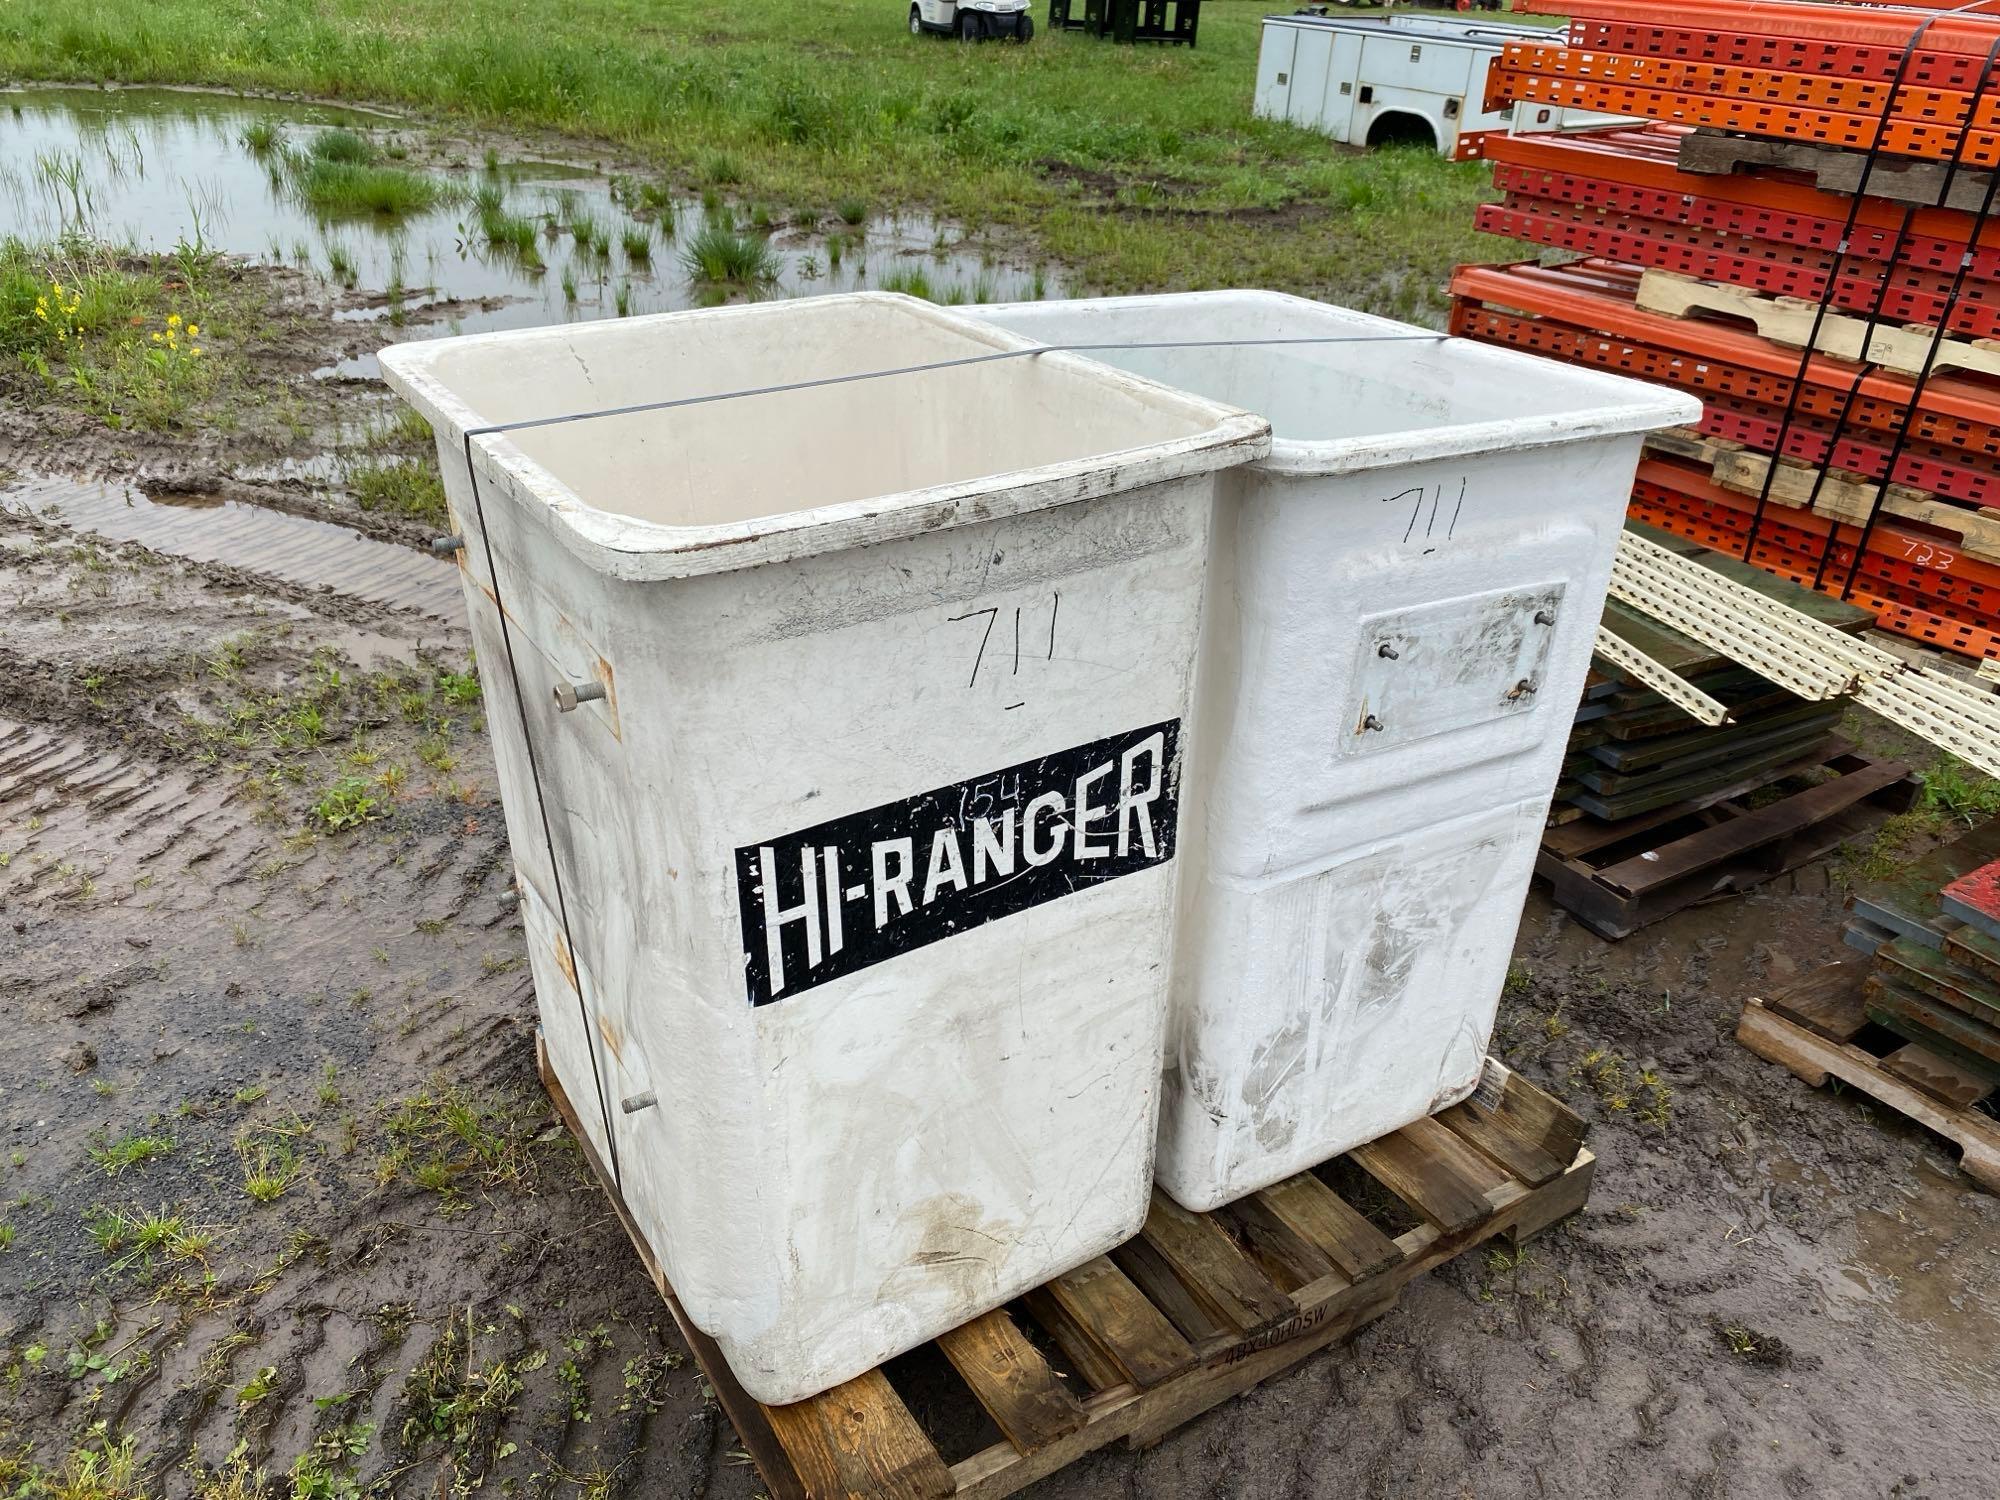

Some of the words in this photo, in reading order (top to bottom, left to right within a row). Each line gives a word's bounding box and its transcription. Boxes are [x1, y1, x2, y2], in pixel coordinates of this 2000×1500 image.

[1382, 476, 1466, 543] 711
[1902, 538, 1954, 570] 723
[947, 591, 1059, 688] 711
[759, 731, 1165, 997] HI-RANGER
